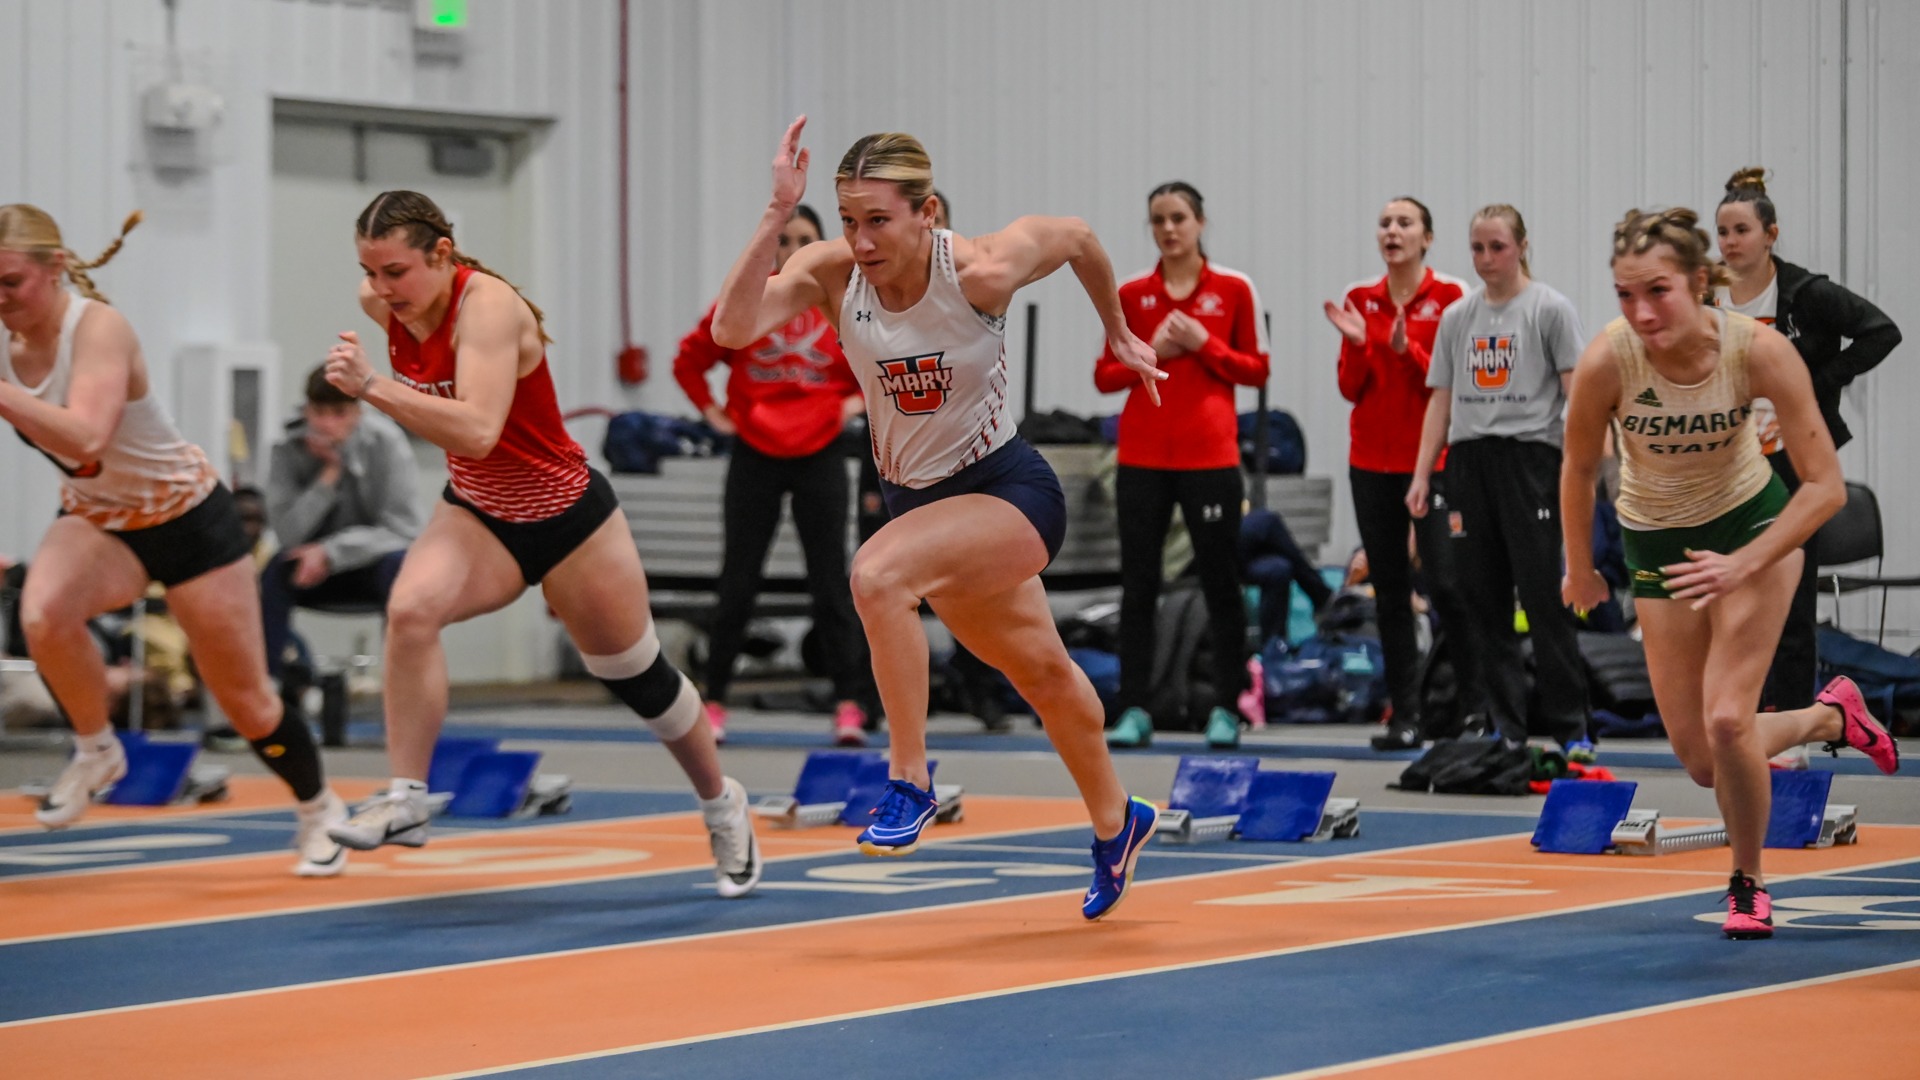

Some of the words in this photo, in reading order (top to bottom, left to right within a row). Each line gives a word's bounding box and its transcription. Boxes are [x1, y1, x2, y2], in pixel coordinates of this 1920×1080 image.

[1466, 347, 1517, 371] MARY
[877, 367, 953, 396] MARY
[1623, 404, 1752, 436] BISMARCK
